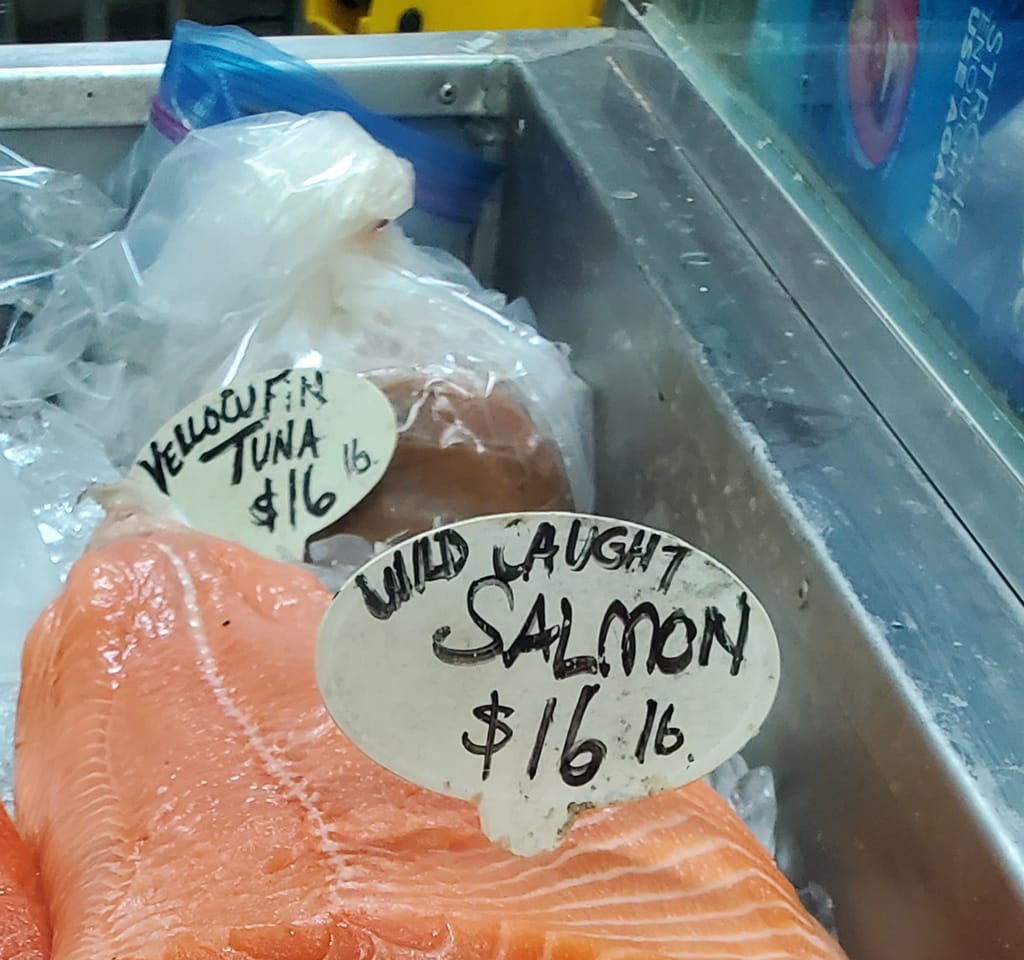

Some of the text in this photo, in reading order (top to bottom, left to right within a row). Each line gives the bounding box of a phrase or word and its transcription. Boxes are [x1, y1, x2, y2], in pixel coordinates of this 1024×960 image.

[199, 416, 321, 485] TUNA
[248, 463, 337, 533] $16
[355, 518, 694, 620] WILD CAUGHT
[432, 574, 751, 681] SALMON
[461, 683, 608, 787] $16
